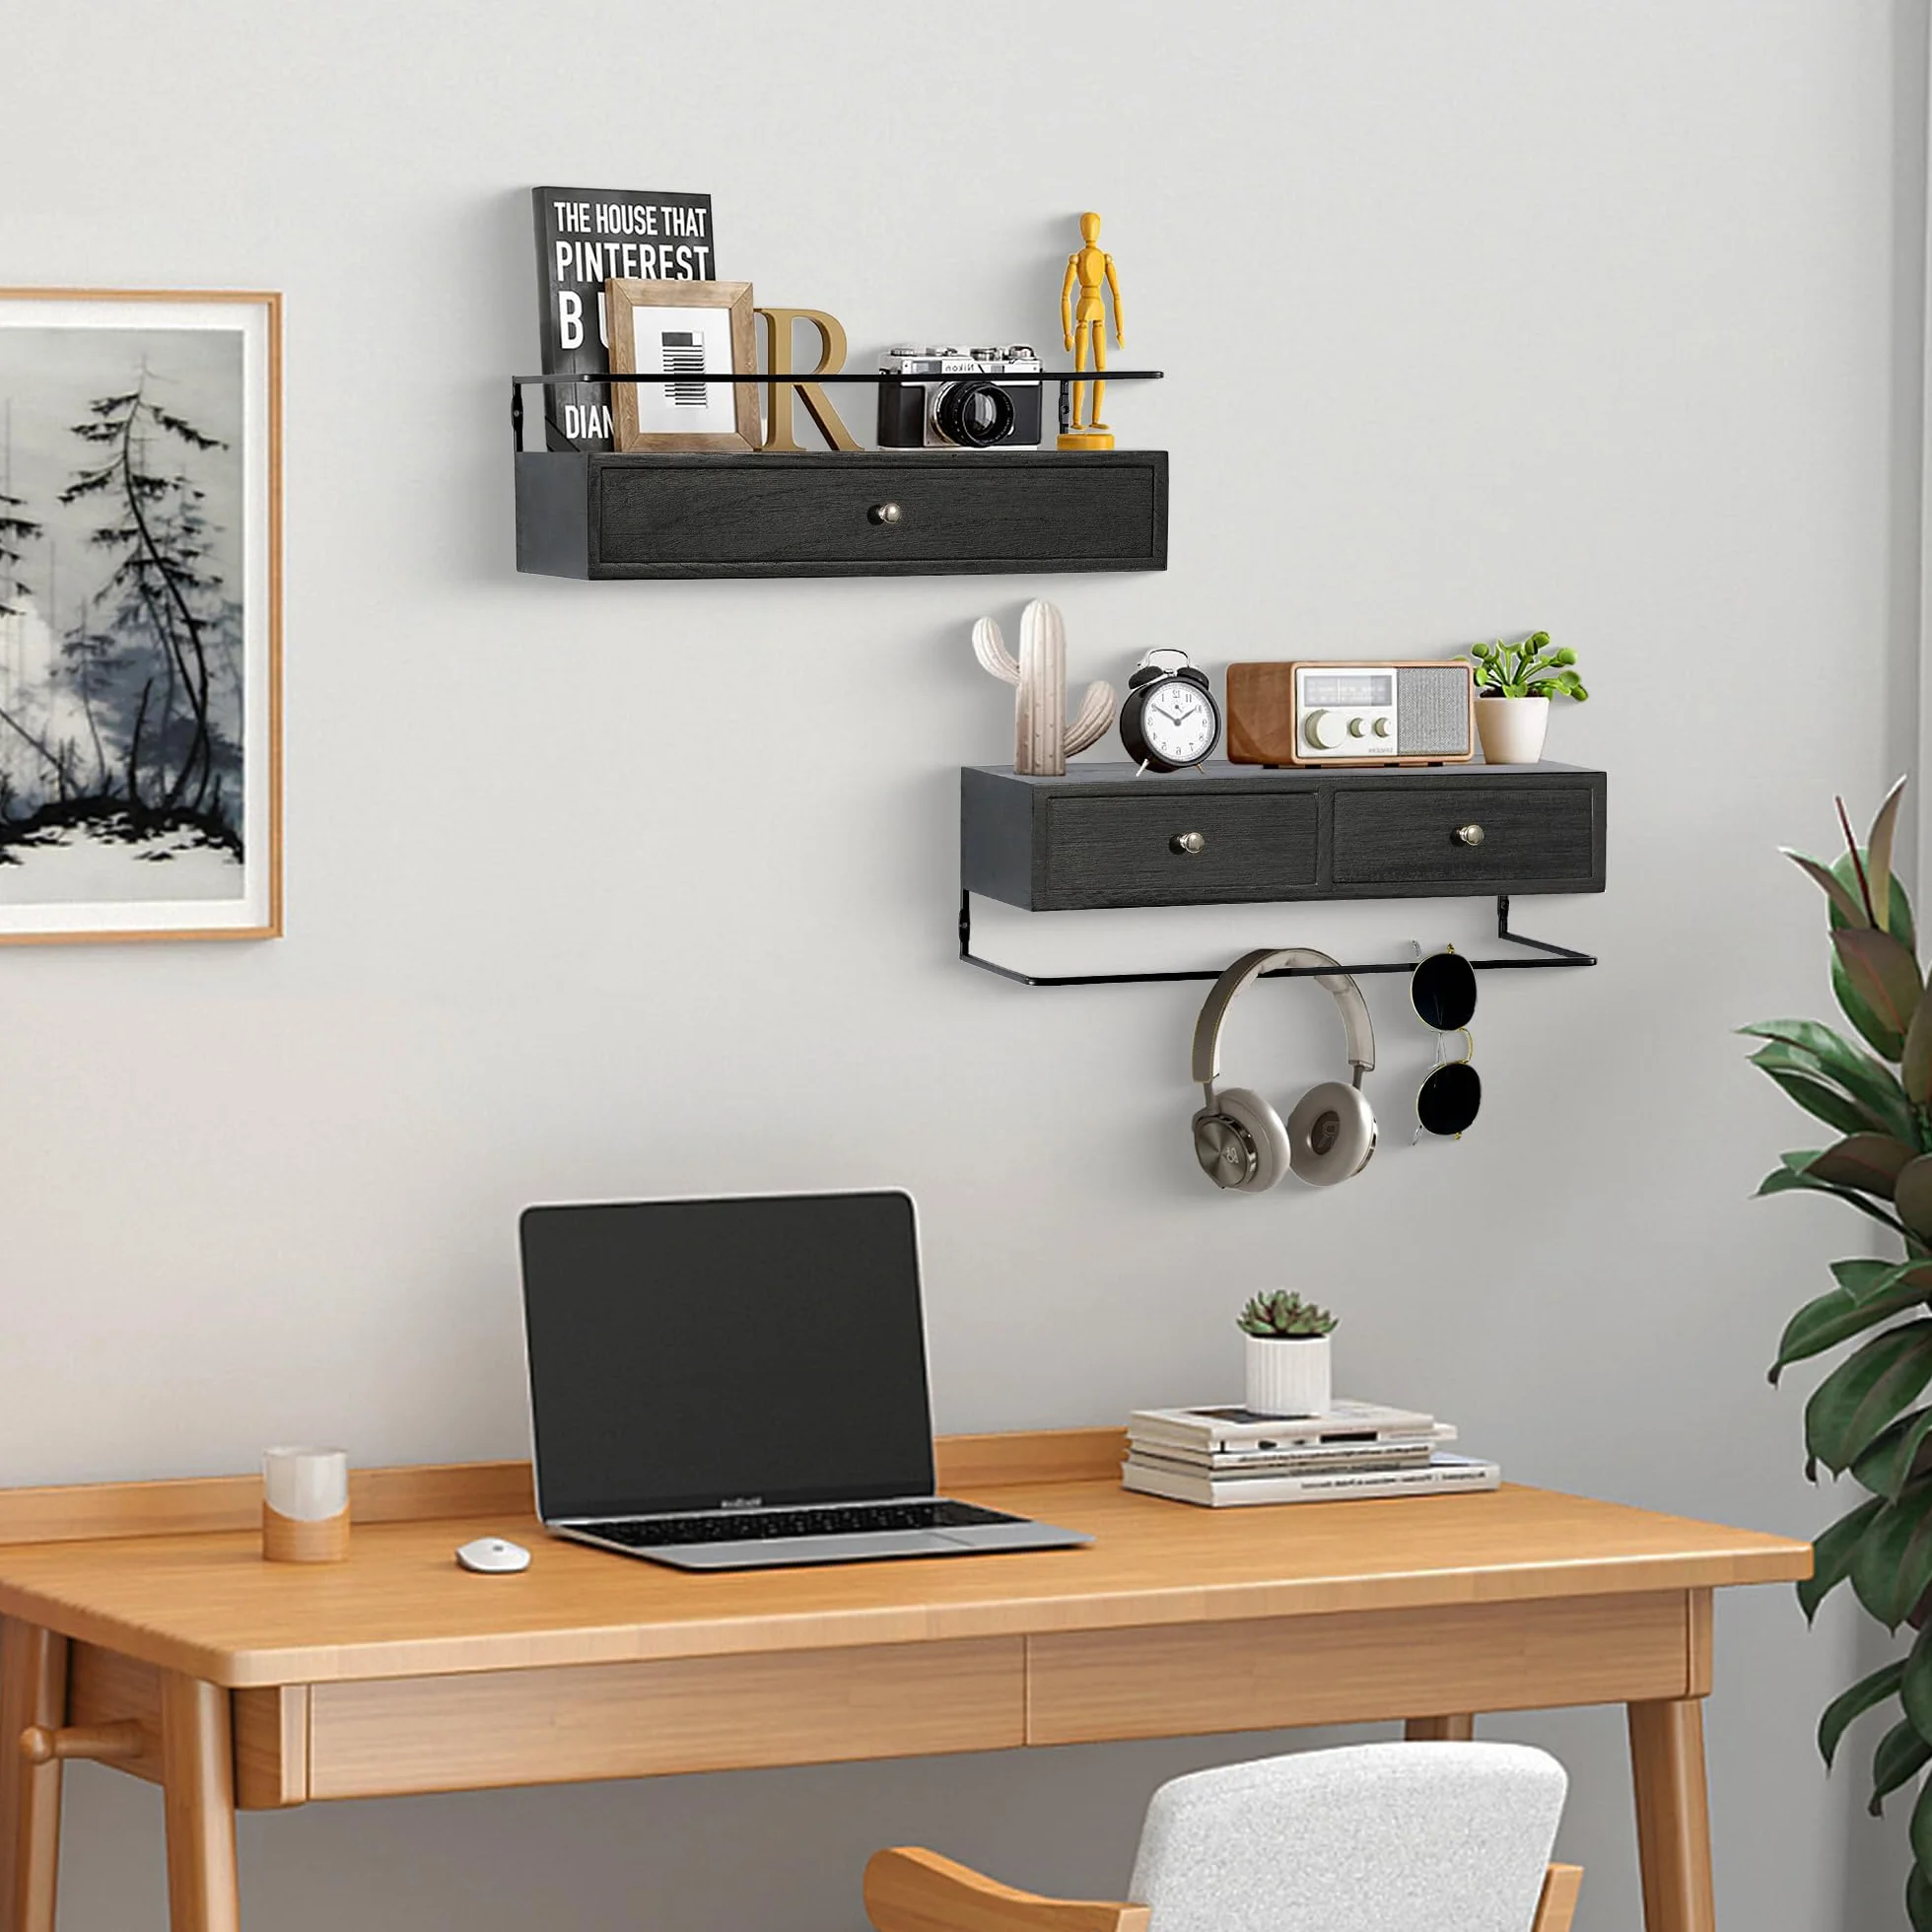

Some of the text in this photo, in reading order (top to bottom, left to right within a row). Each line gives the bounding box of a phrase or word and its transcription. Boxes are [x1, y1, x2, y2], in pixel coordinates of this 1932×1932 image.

[553, 201, 707, 238] THE HOUSE THAT
[555, 241, 709, 282] PINTEREST
[753, 309, 865, 451] R
